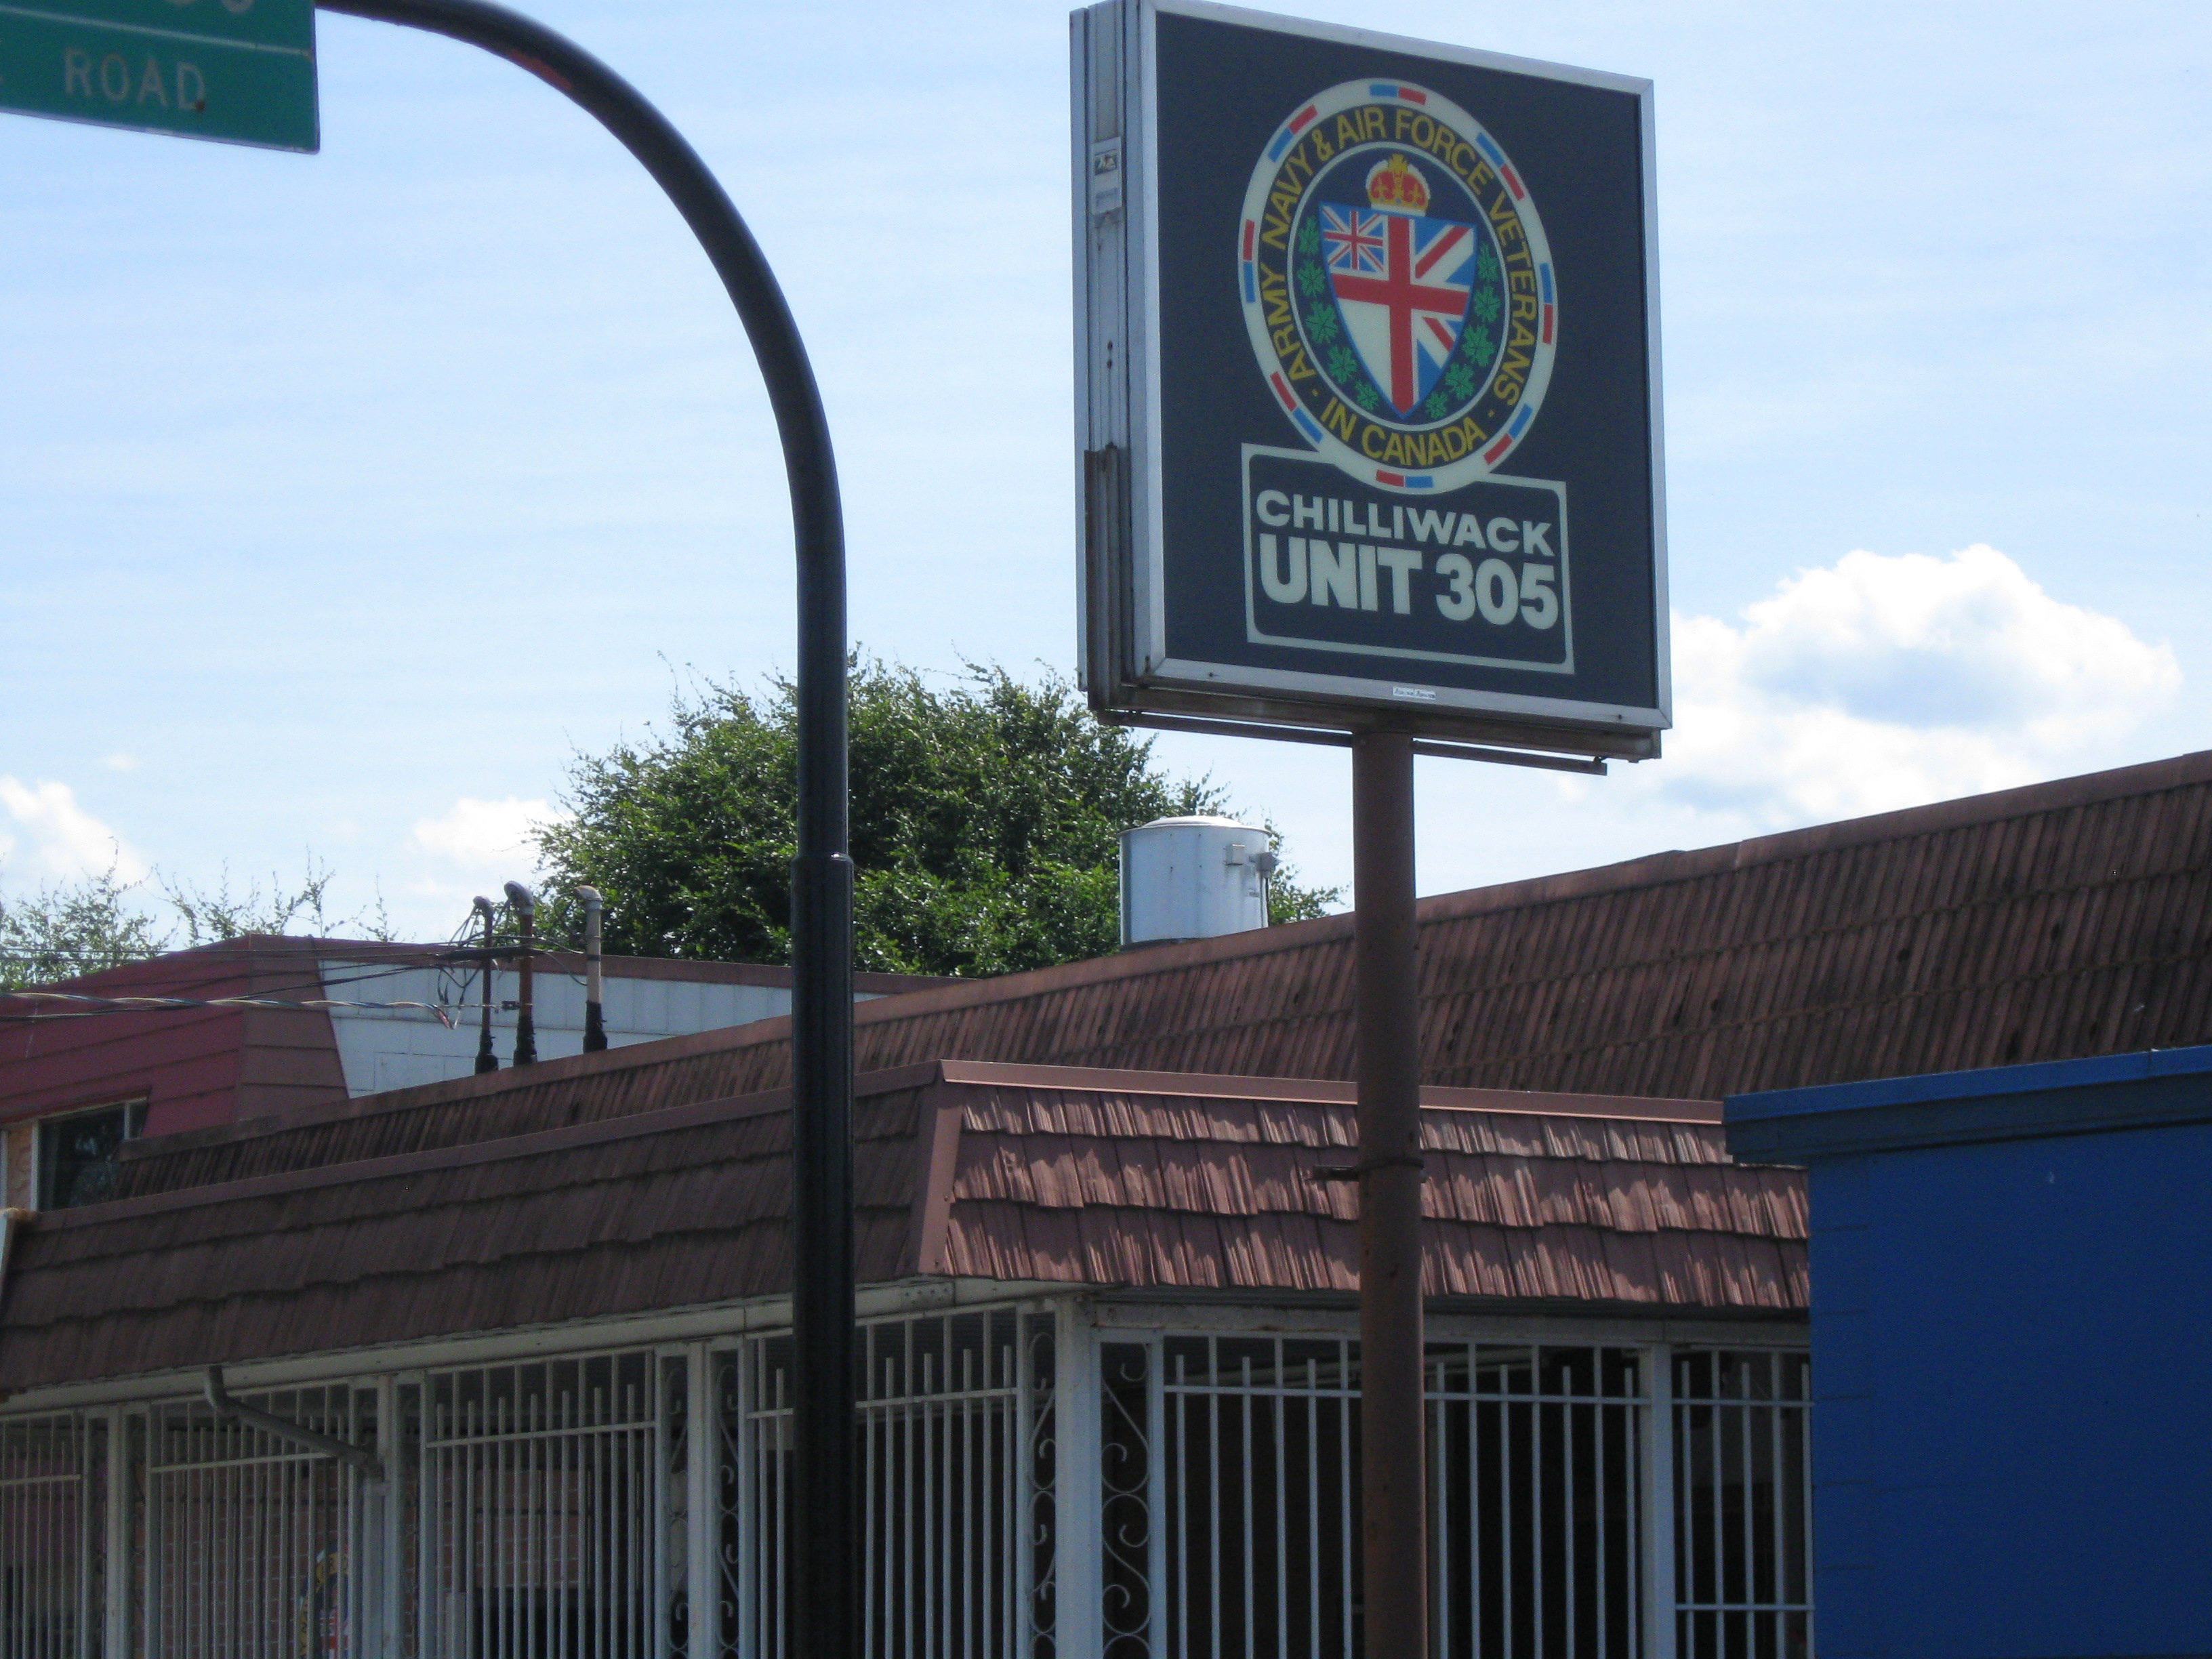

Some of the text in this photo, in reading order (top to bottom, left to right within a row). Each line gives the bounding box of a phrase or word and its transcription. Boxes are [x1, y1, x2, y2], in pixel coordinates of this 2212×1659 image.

[64, 48, 205, 110] ROAD
[1260, 106, 1538, 406] ARMY NAVY & AIR FORCE VETERANS
[1319, 396, 1488, 466] IN CANADA
[1255, 489, 1555, 557] CHILLIWACK
[1258, 532, 1559, 630] UNIT 305
